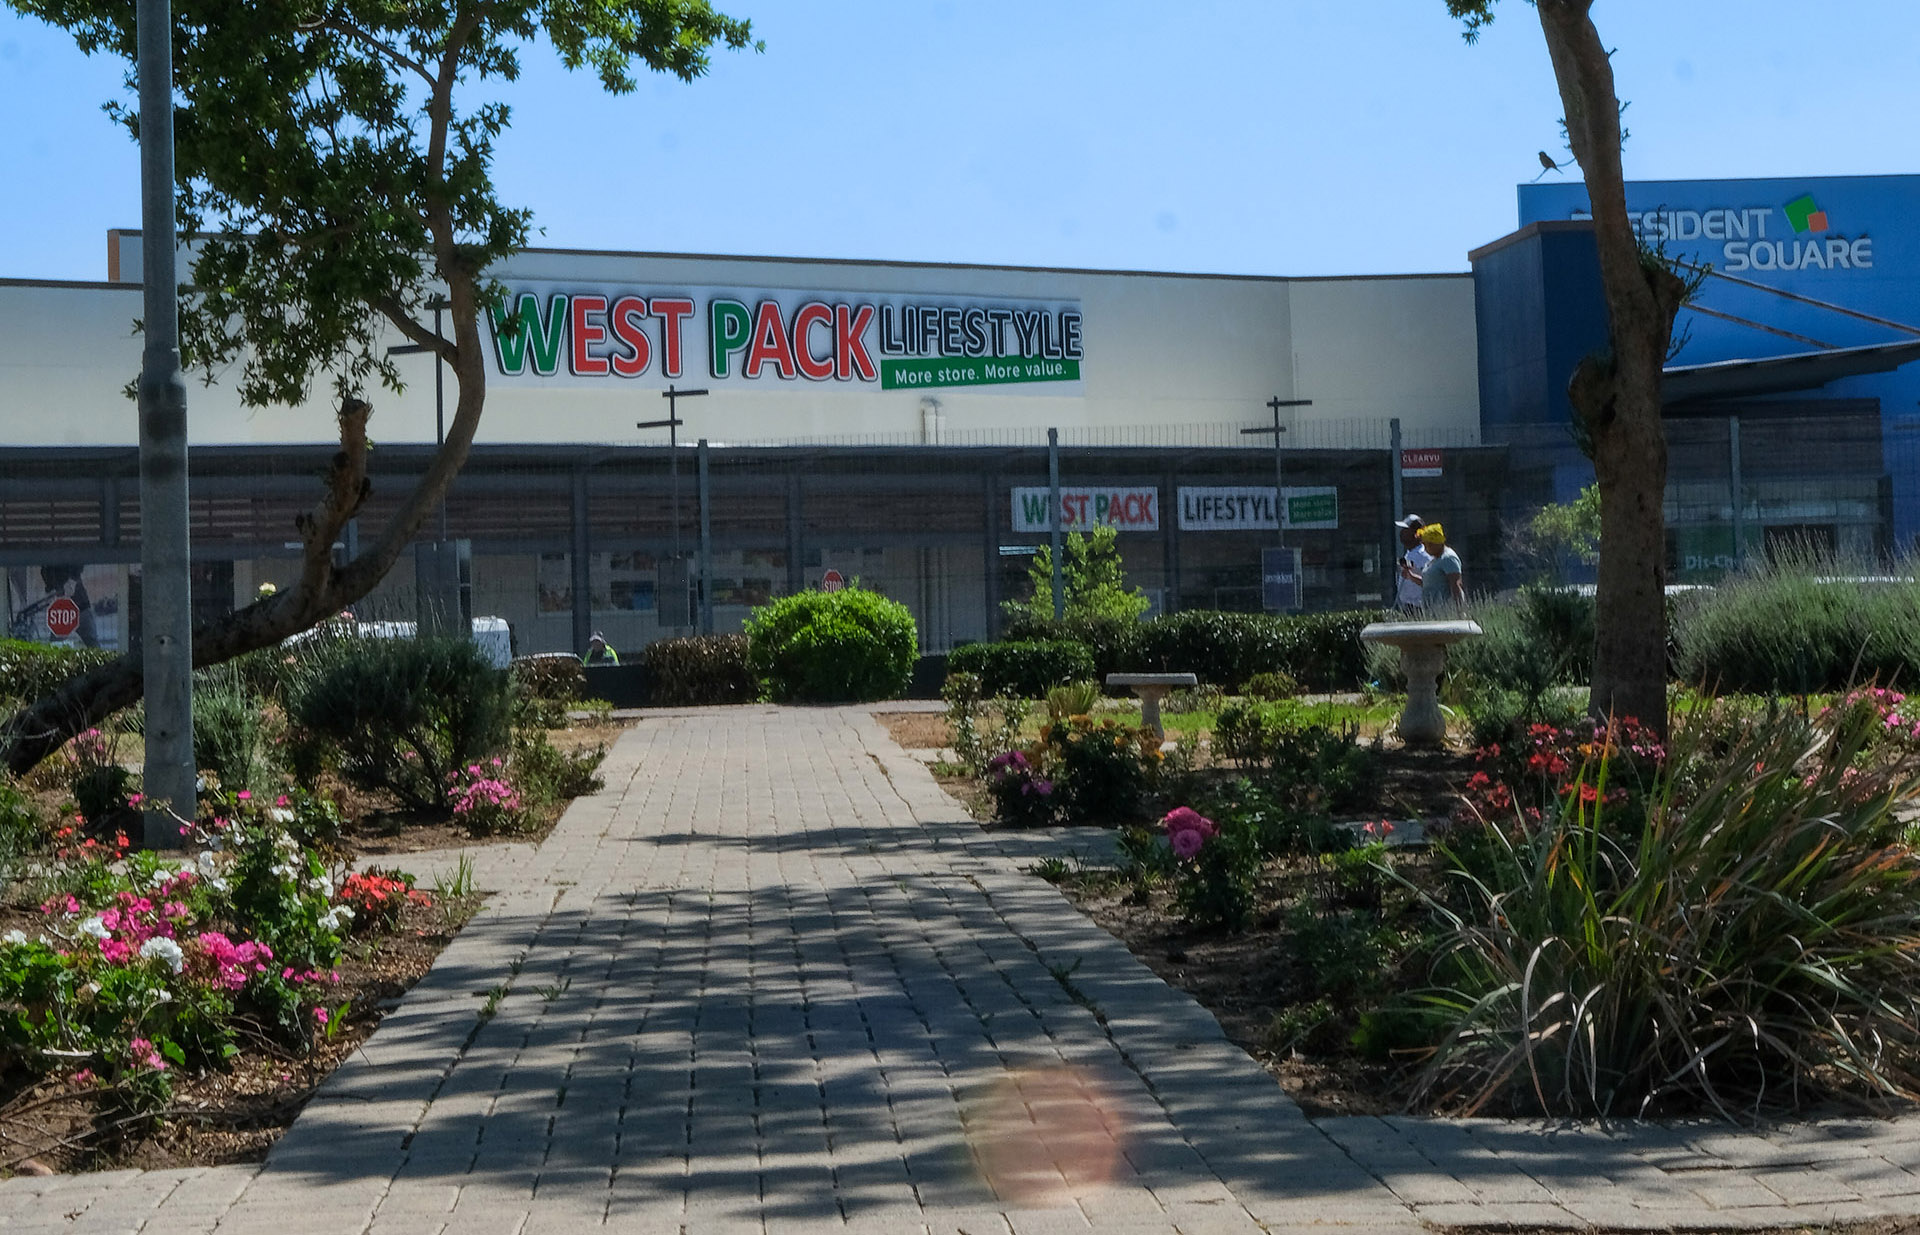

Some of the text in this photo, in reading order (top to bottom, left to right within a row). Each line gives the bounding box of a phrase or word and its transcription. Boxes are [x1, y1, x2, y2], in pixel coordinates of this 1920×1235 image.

[1571, 208, 1773, 242] ESIDENT
[1723, 237, 1873, 272] SQUARE
[486, 293, 1084, 381] WEST PACK LIFESTYLE
[895, 360, 1067, 385] More store. More value.
[1022, 493, 1155, 524] WST PACK
[1184, 494, 1286, 522] LIFESTYLE
[824, 580, 841, 593] STOP
[50, 609, 77, 625] STOP
